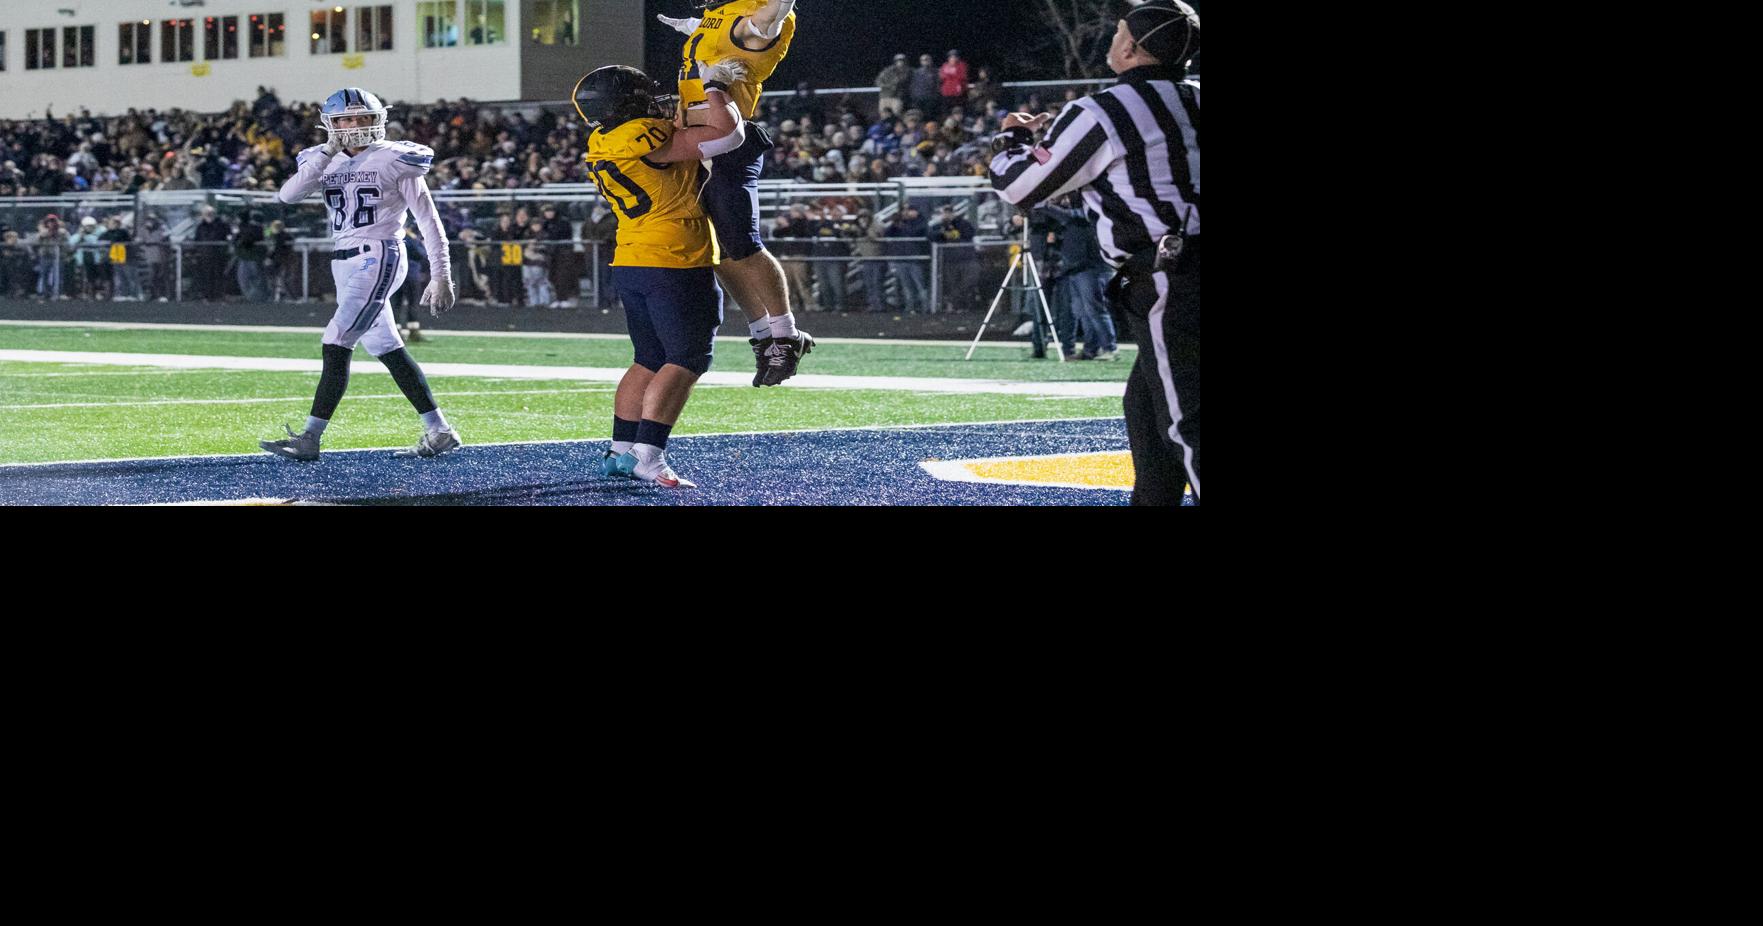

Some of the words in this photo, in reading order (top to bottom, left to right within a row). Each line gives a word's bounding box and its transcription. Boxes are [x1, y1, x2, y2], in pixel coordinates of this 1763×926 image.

[698, 17, 723, 30] LORD
[635, 126, 668, 151] 70
[322, 170, 378, 186] PETOSKEY
[323, 185, 384, 233] 86
